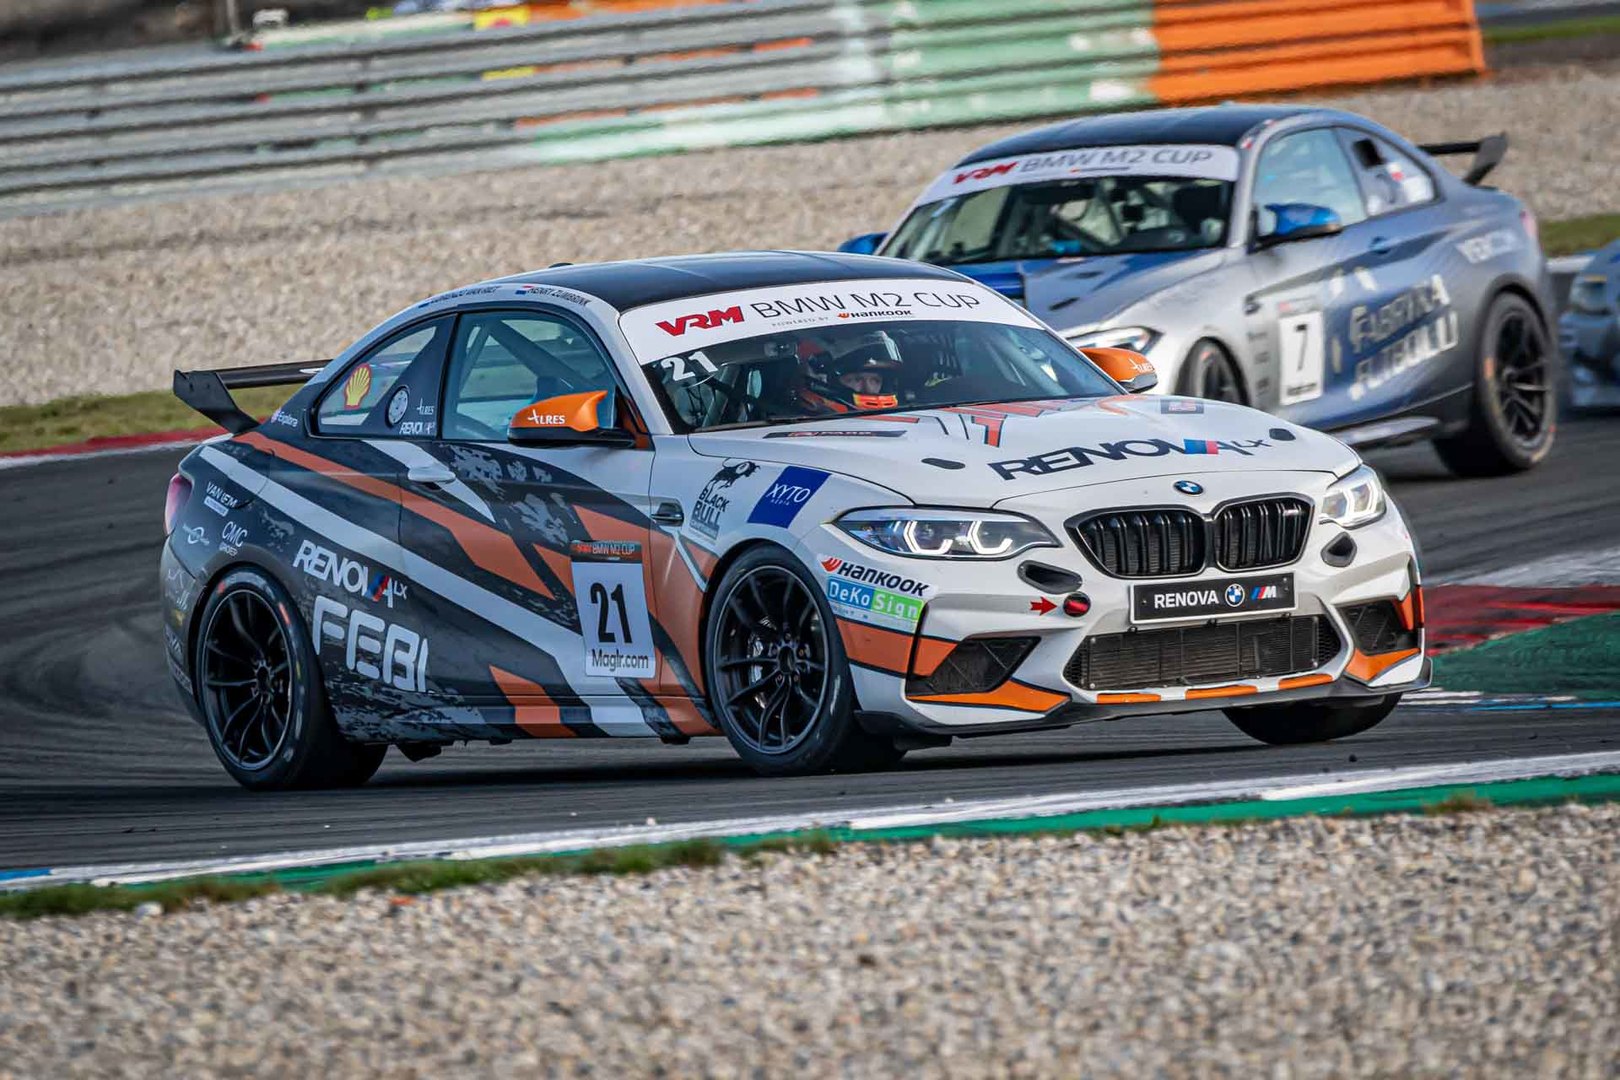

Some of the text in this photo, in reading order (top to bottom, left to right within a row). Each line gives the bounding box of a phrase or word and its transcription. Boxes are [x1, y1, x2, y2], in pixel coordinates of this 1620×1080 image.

[1021, 152, 1097, 173] BMW
[1101, 150, 1147, 165] M2
[1151, 149, 1213, 165] CUP
[655, 292, 980, 337] VRM BMW M2 CUP
[1294, 323, 1308, 372] 7
[661, 351, 719, 382] 21
[699, 487, 730, 513] BLACK
[765, 483, 811, 503] XYTO
[690, 500, 721, 528] BULL
[222, 520, 248, 548] CMC
[590, 582, 633, 644] 21
[1154, 590, 1220, 609] RENOVA
[312, 595, 429, 693] FEBI
